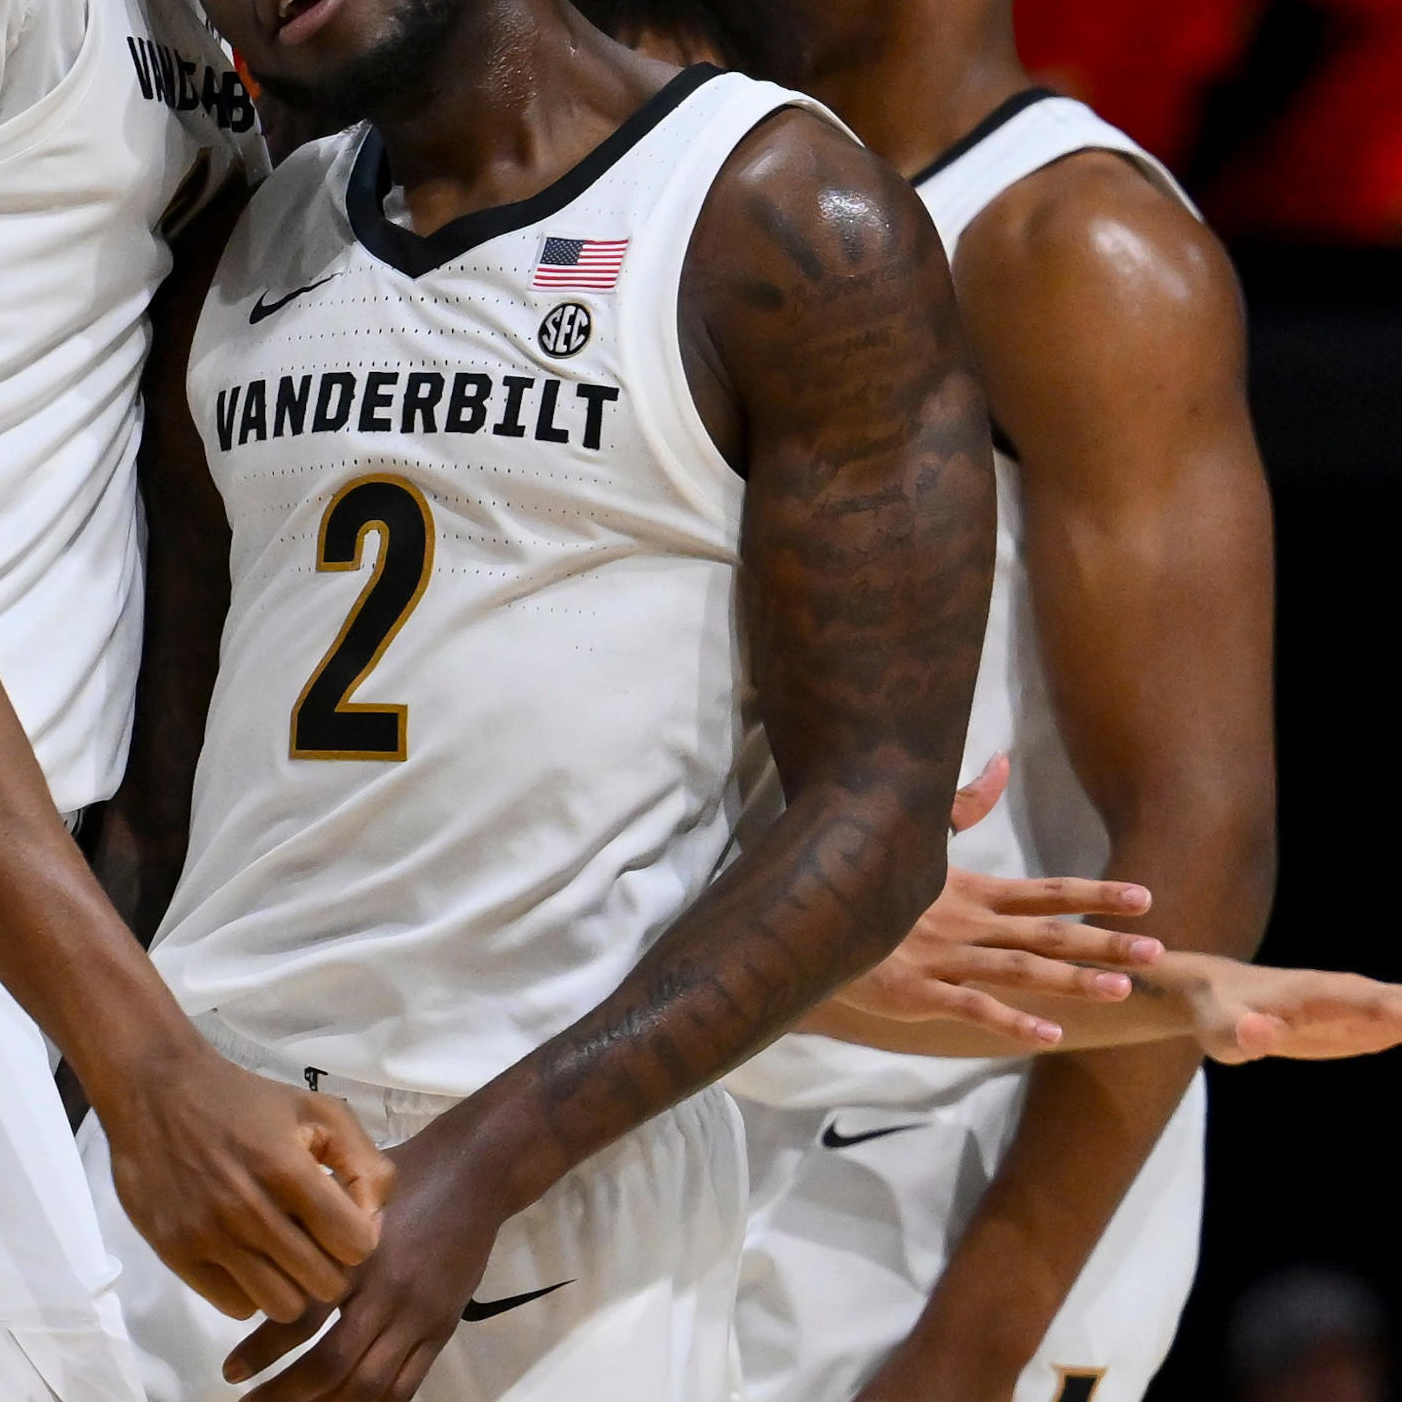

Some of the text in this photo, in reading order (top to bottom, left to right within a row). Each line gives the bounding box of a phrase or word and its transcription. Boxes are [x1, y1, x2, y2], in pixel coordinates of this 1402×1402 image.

[540, 304, 590, 356] SEC
[216, 371, 620, 451] VANDERBILT
[289, 472, 436, 762] 2
